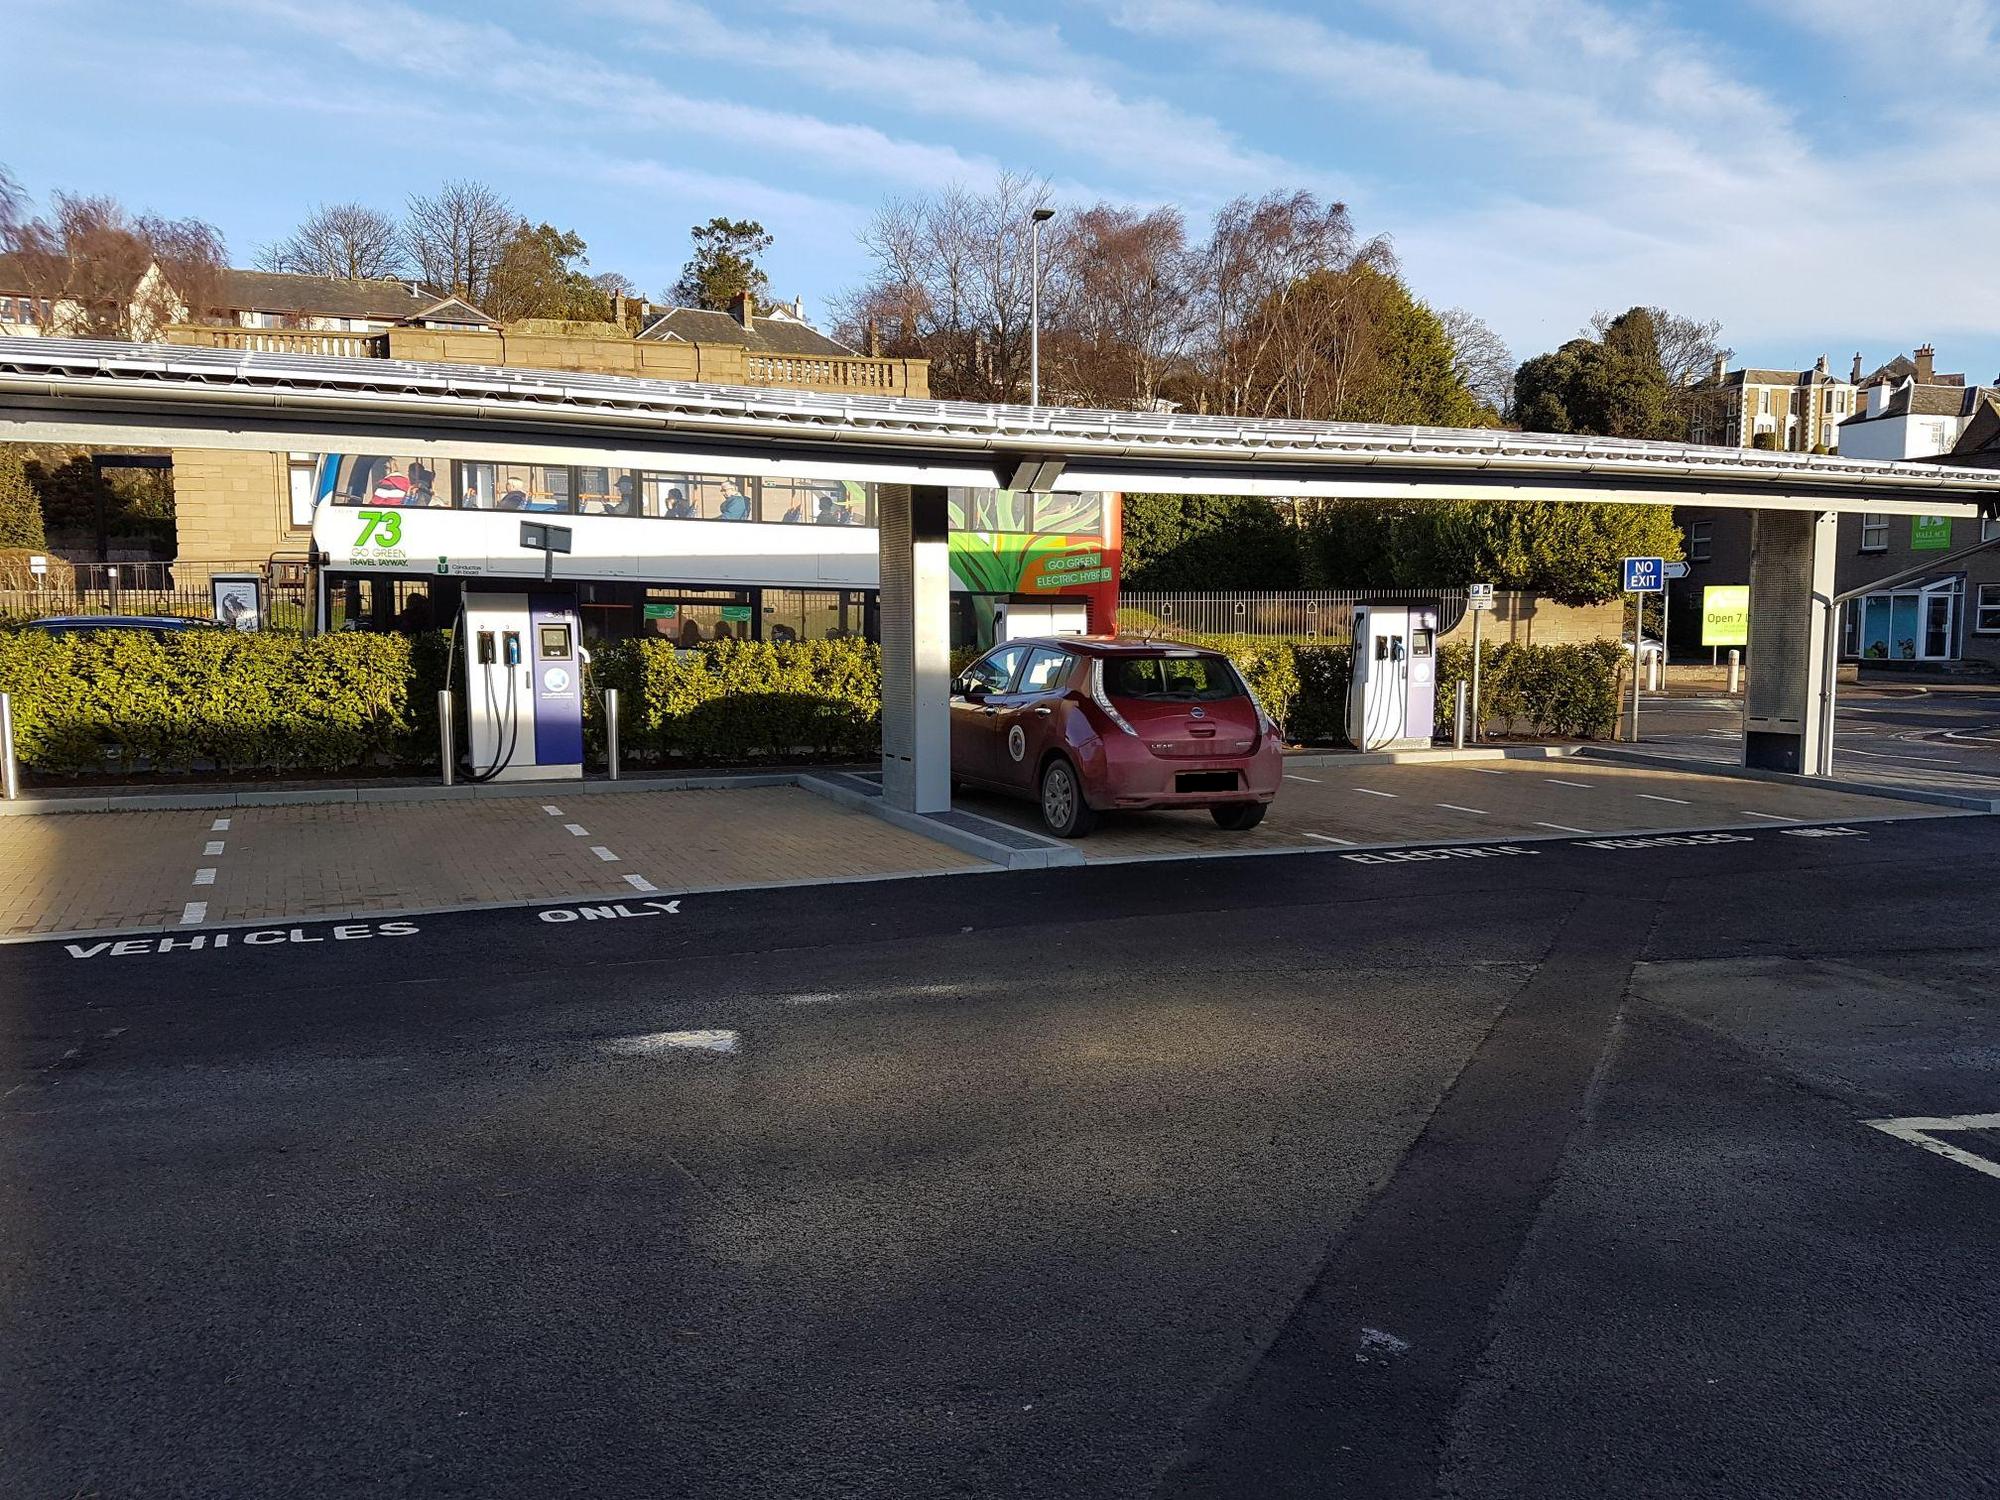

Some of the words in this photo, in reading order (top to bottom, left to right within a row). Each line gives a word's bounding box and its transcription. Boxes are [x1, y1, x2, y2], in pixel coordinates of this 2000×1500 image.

[354, 511, 402, 547] 73
[351, 548, 369, 557] GO
[372, 549, 406, 558] GREEN
[350, 558, 376, 566] TRAVEL
[1048, 559, 1065, 570] GO
[1066, 556, 1099, 568] GREEN
[1635, 561, 1654, 574] NO
[1037, 572, 1080, 586] ELECTRIC
[1080, 569, 1112, 582] HYBRID
[1631, 574, 1657, 587] EXIT
[1707, 613, 1733, 625] Open
[1736, 613, 1742, 622] 7
[1339, 846, 1542, 864] ELECTRIC
[64, 922, 420, 959] VEHICLES
[538, 900, 681, 923] ONLY
